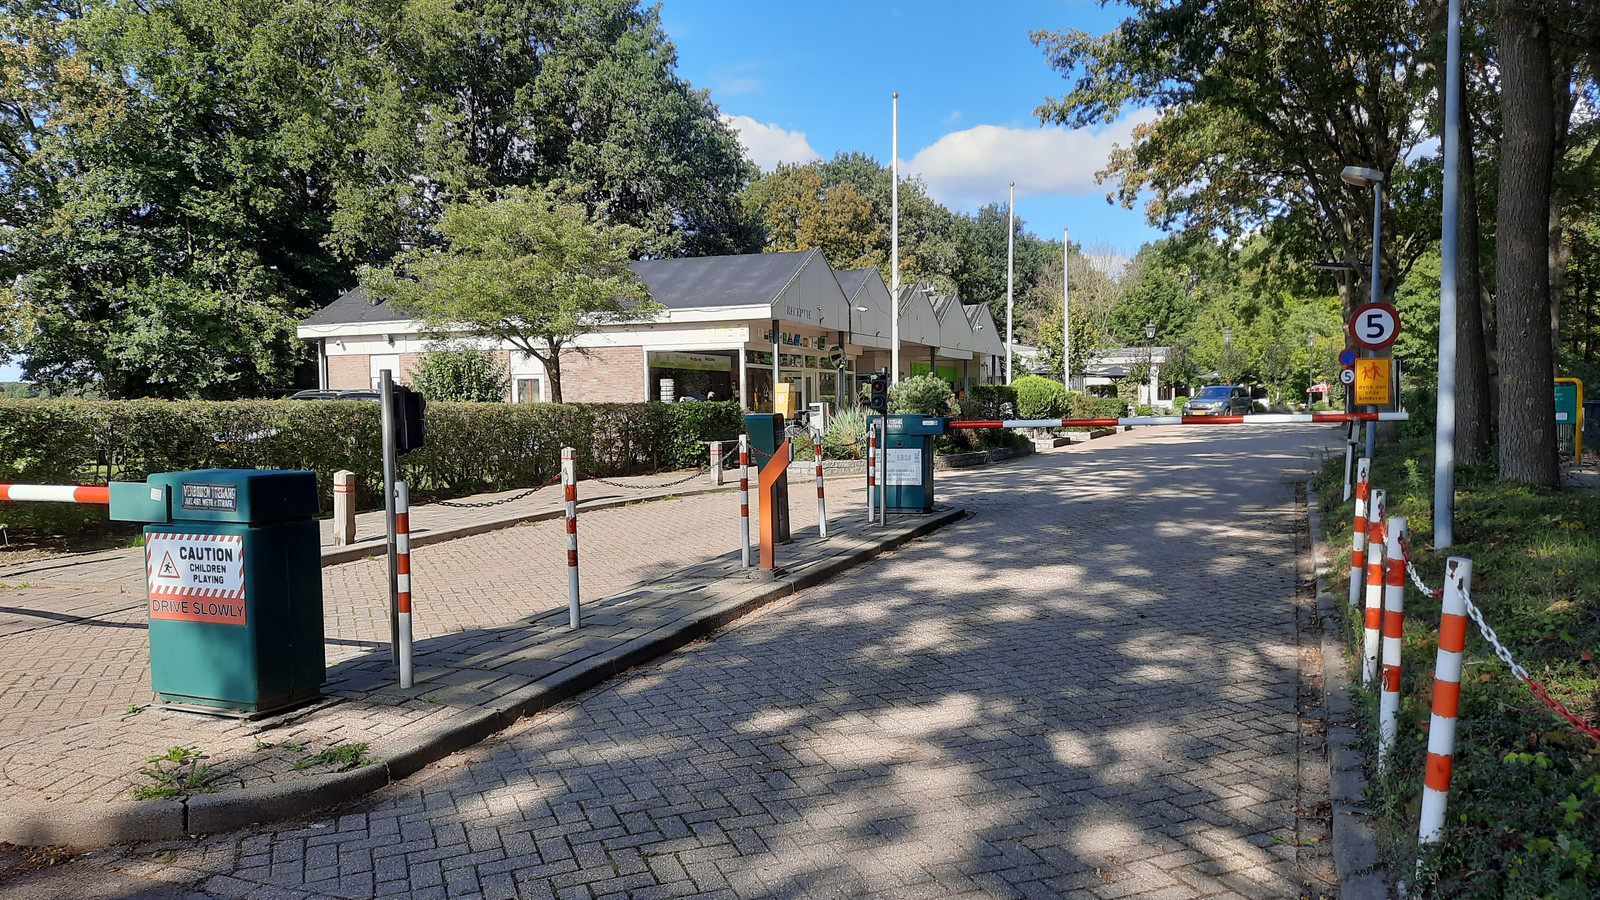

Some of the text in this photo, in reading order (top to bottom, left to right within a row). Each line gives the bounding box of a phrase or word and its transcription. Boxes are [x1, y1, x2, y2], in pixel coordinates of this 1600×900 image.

[786, 305, 812, 320] RECEPTIE
[1366, 313, 1385, 339] 5
[1344, 371, 1352, 382] 5
[183, 485, 211, 498] VERBODEN
[179, 546, 233, 562] CAUTION
[189, 563, 227, 574] CHILDREN
[193, 574, 224, 584] PLAYING
[152, 599, 244, 618] DRIVE SLOWLY
